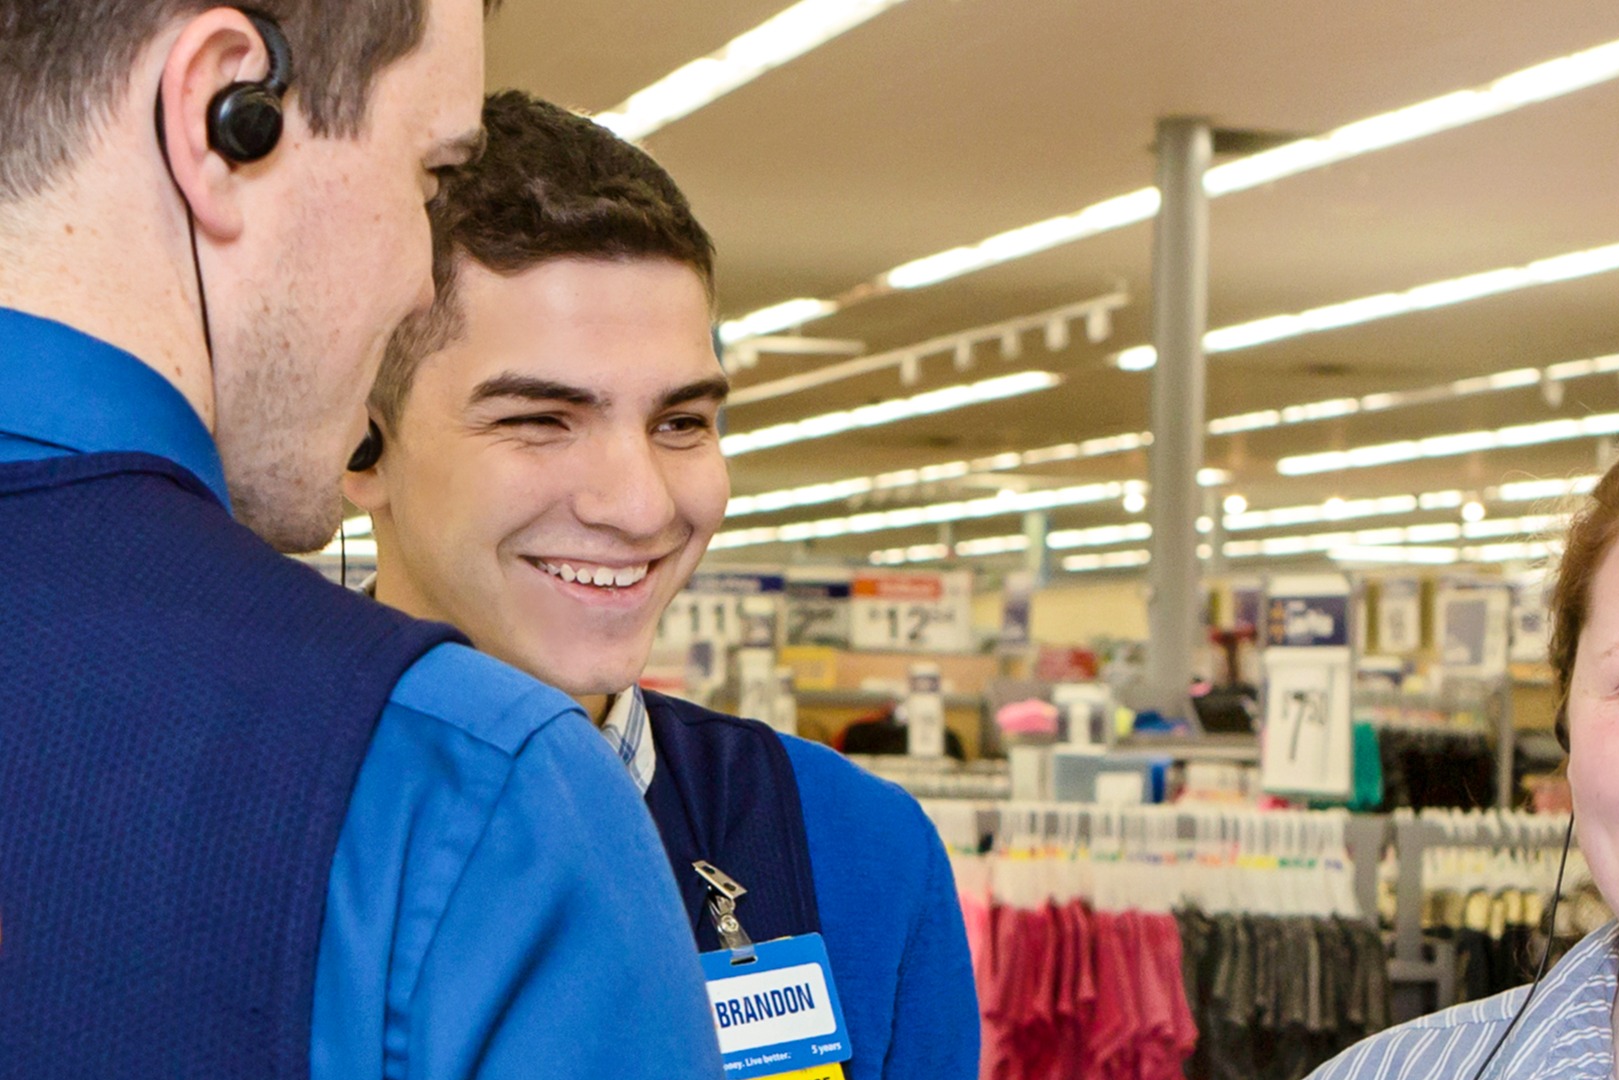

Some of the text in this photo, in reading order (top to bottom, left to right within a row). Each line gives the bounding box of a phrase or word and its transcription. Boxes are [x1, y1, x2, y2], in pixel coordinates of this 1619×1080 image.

[715, 982, 816, 1029] BRANDON
[811, 1041, 842, 1056] 5 years
[745, 1054, 763, 1068] Live
